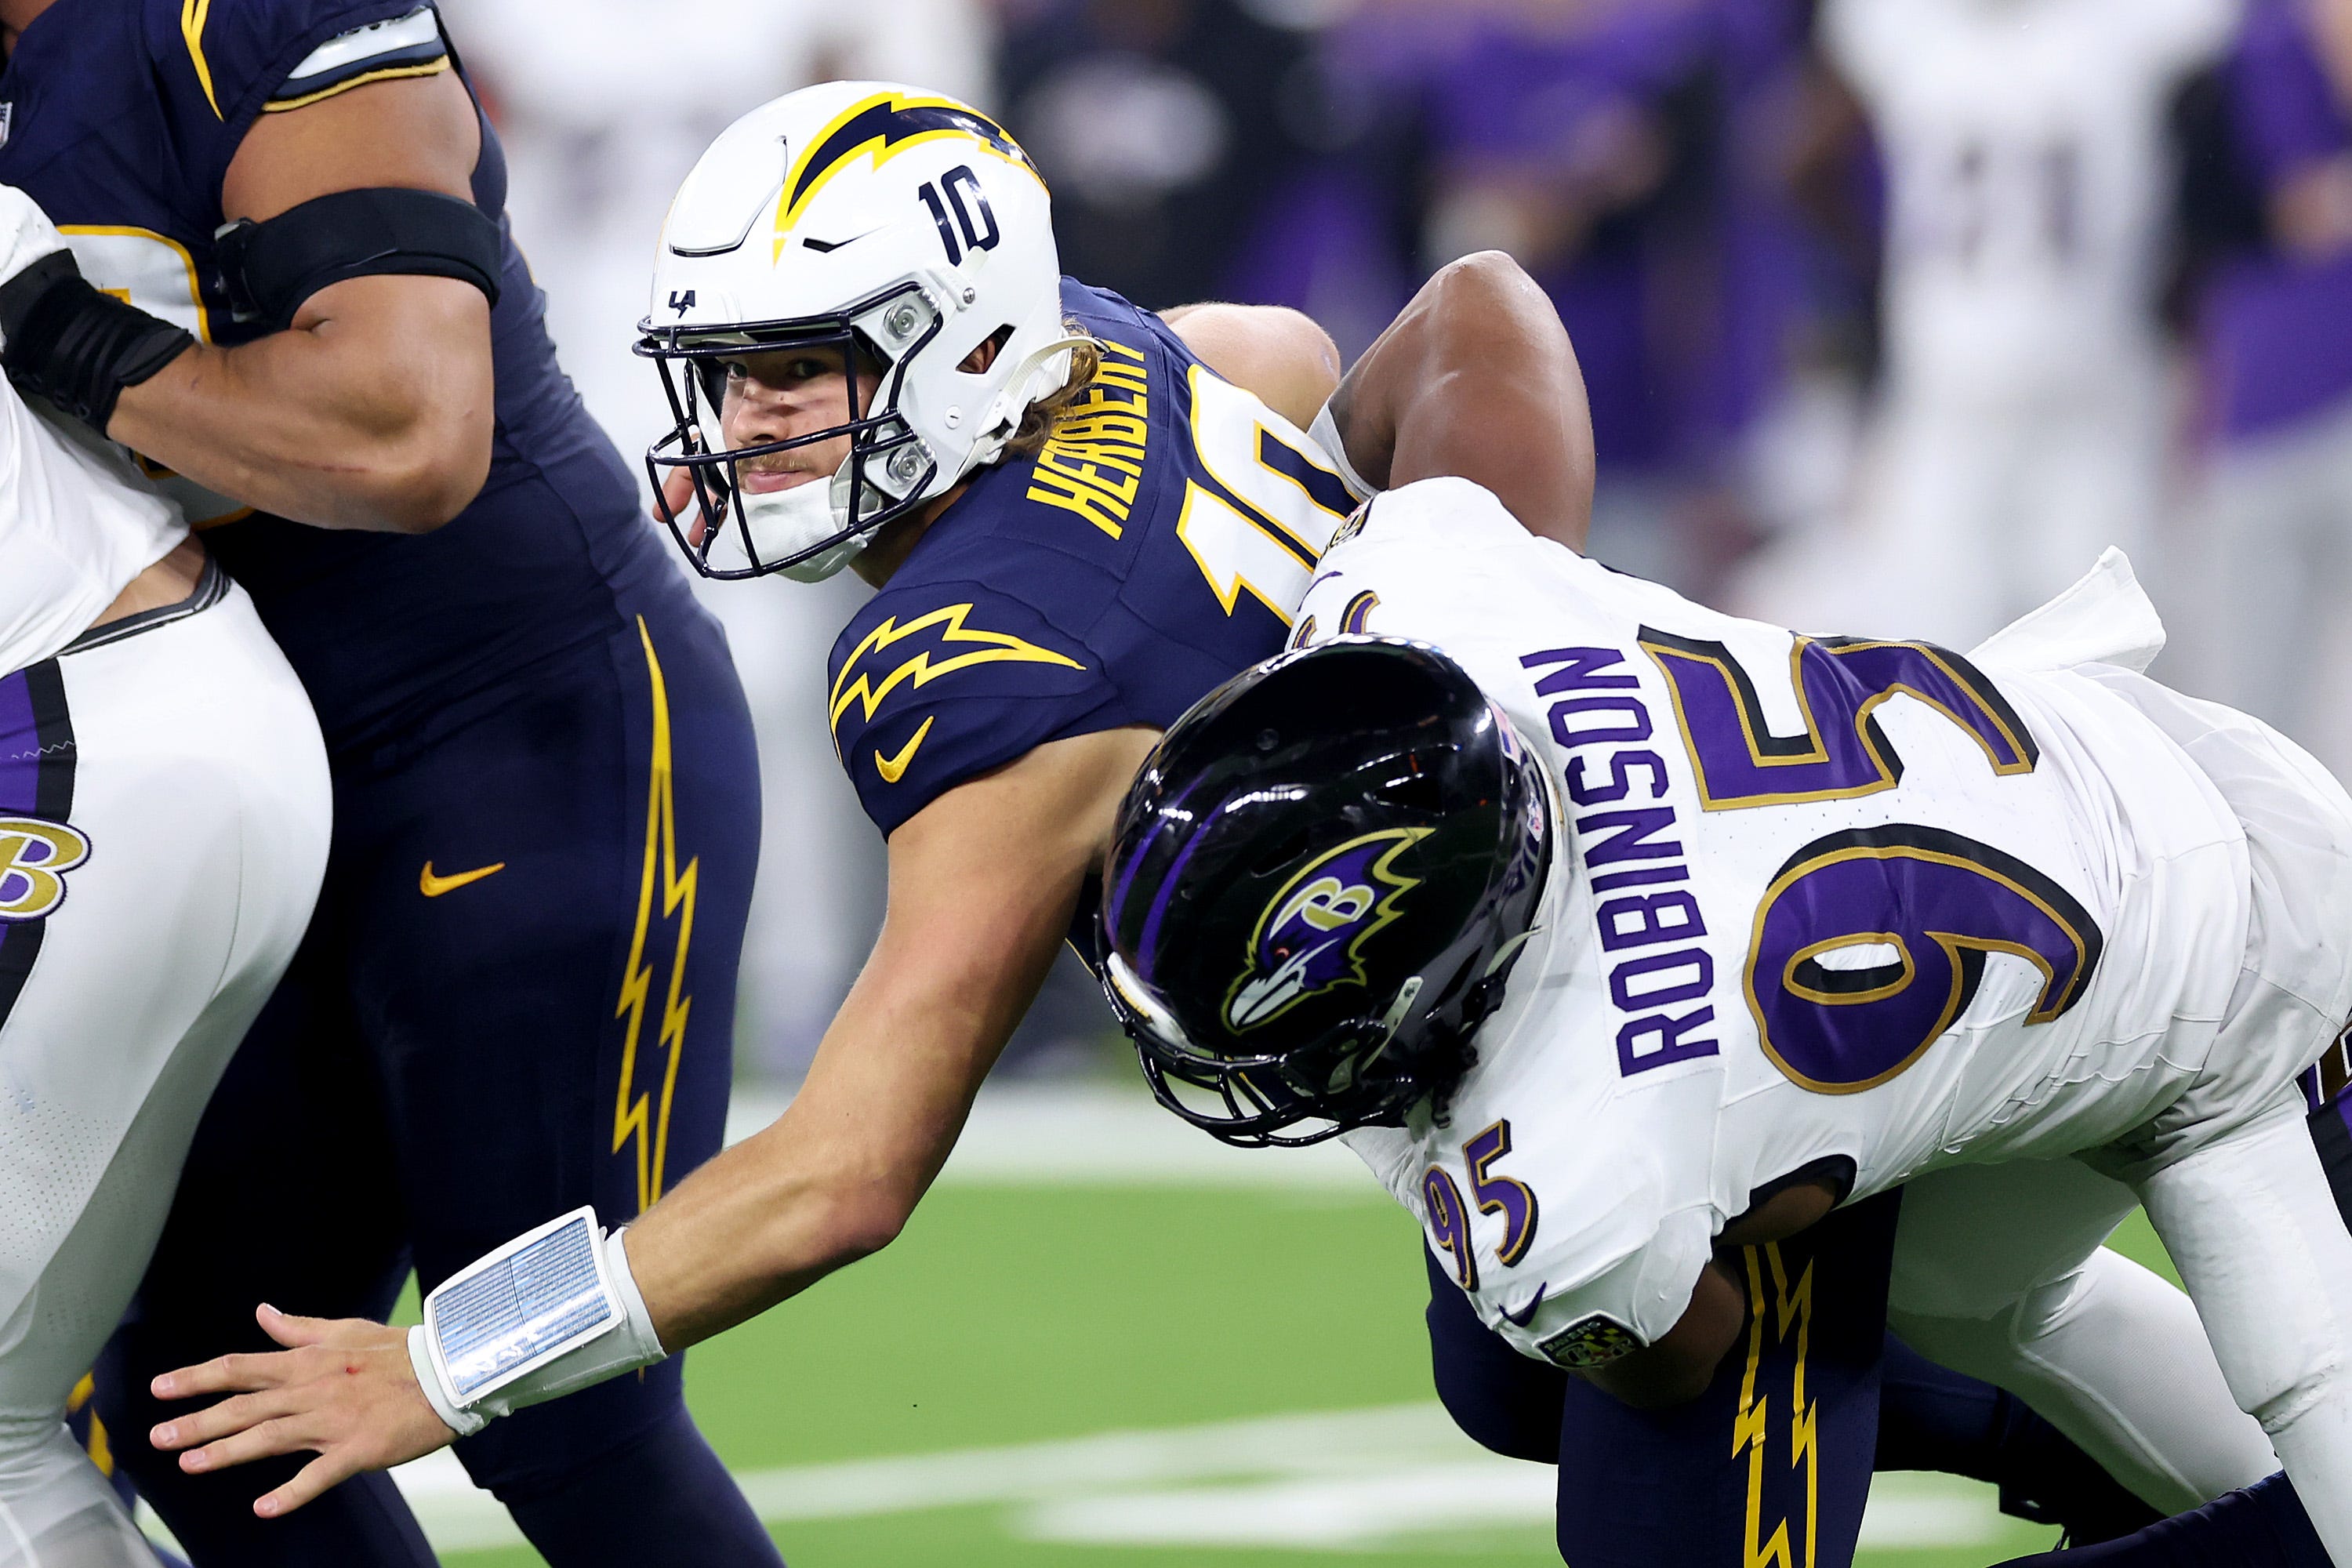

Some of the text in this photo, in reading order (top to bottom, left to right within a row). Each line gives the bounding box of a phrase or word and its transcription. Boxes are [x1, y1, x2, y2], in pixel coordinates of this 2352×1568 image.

[918, 164, 1000, 267] 10
[1519, 645, 1720, 1078] ROBINSON
[1638, 623, 2104, 1096] 95
[1423, 1117, 1539, 1292] 95
